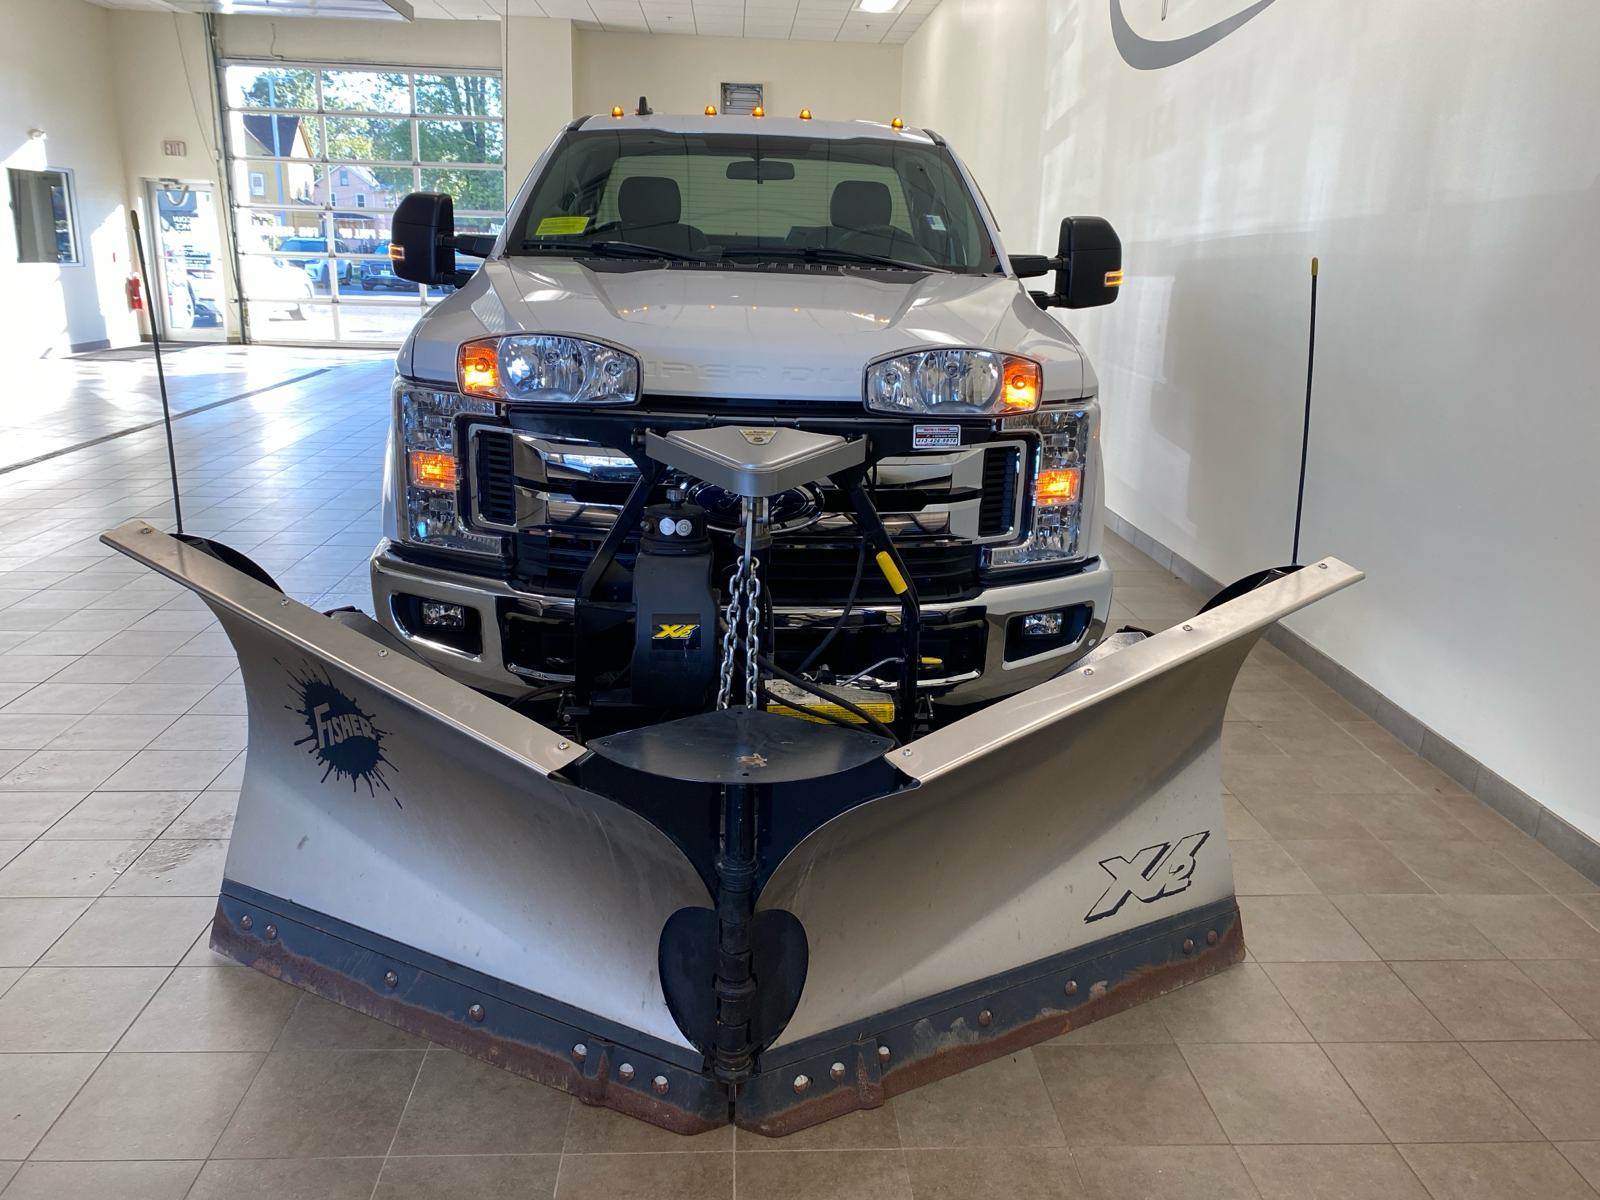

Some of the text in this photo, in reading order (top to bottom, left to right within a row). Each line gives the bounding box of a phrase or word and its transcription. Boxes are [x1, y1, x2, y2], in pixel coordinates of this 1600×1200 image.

[164, 142, 181, 156] EXIT
[643, 360, 862, 384] PER DU
[313, 702, 377, 750] FISHER
